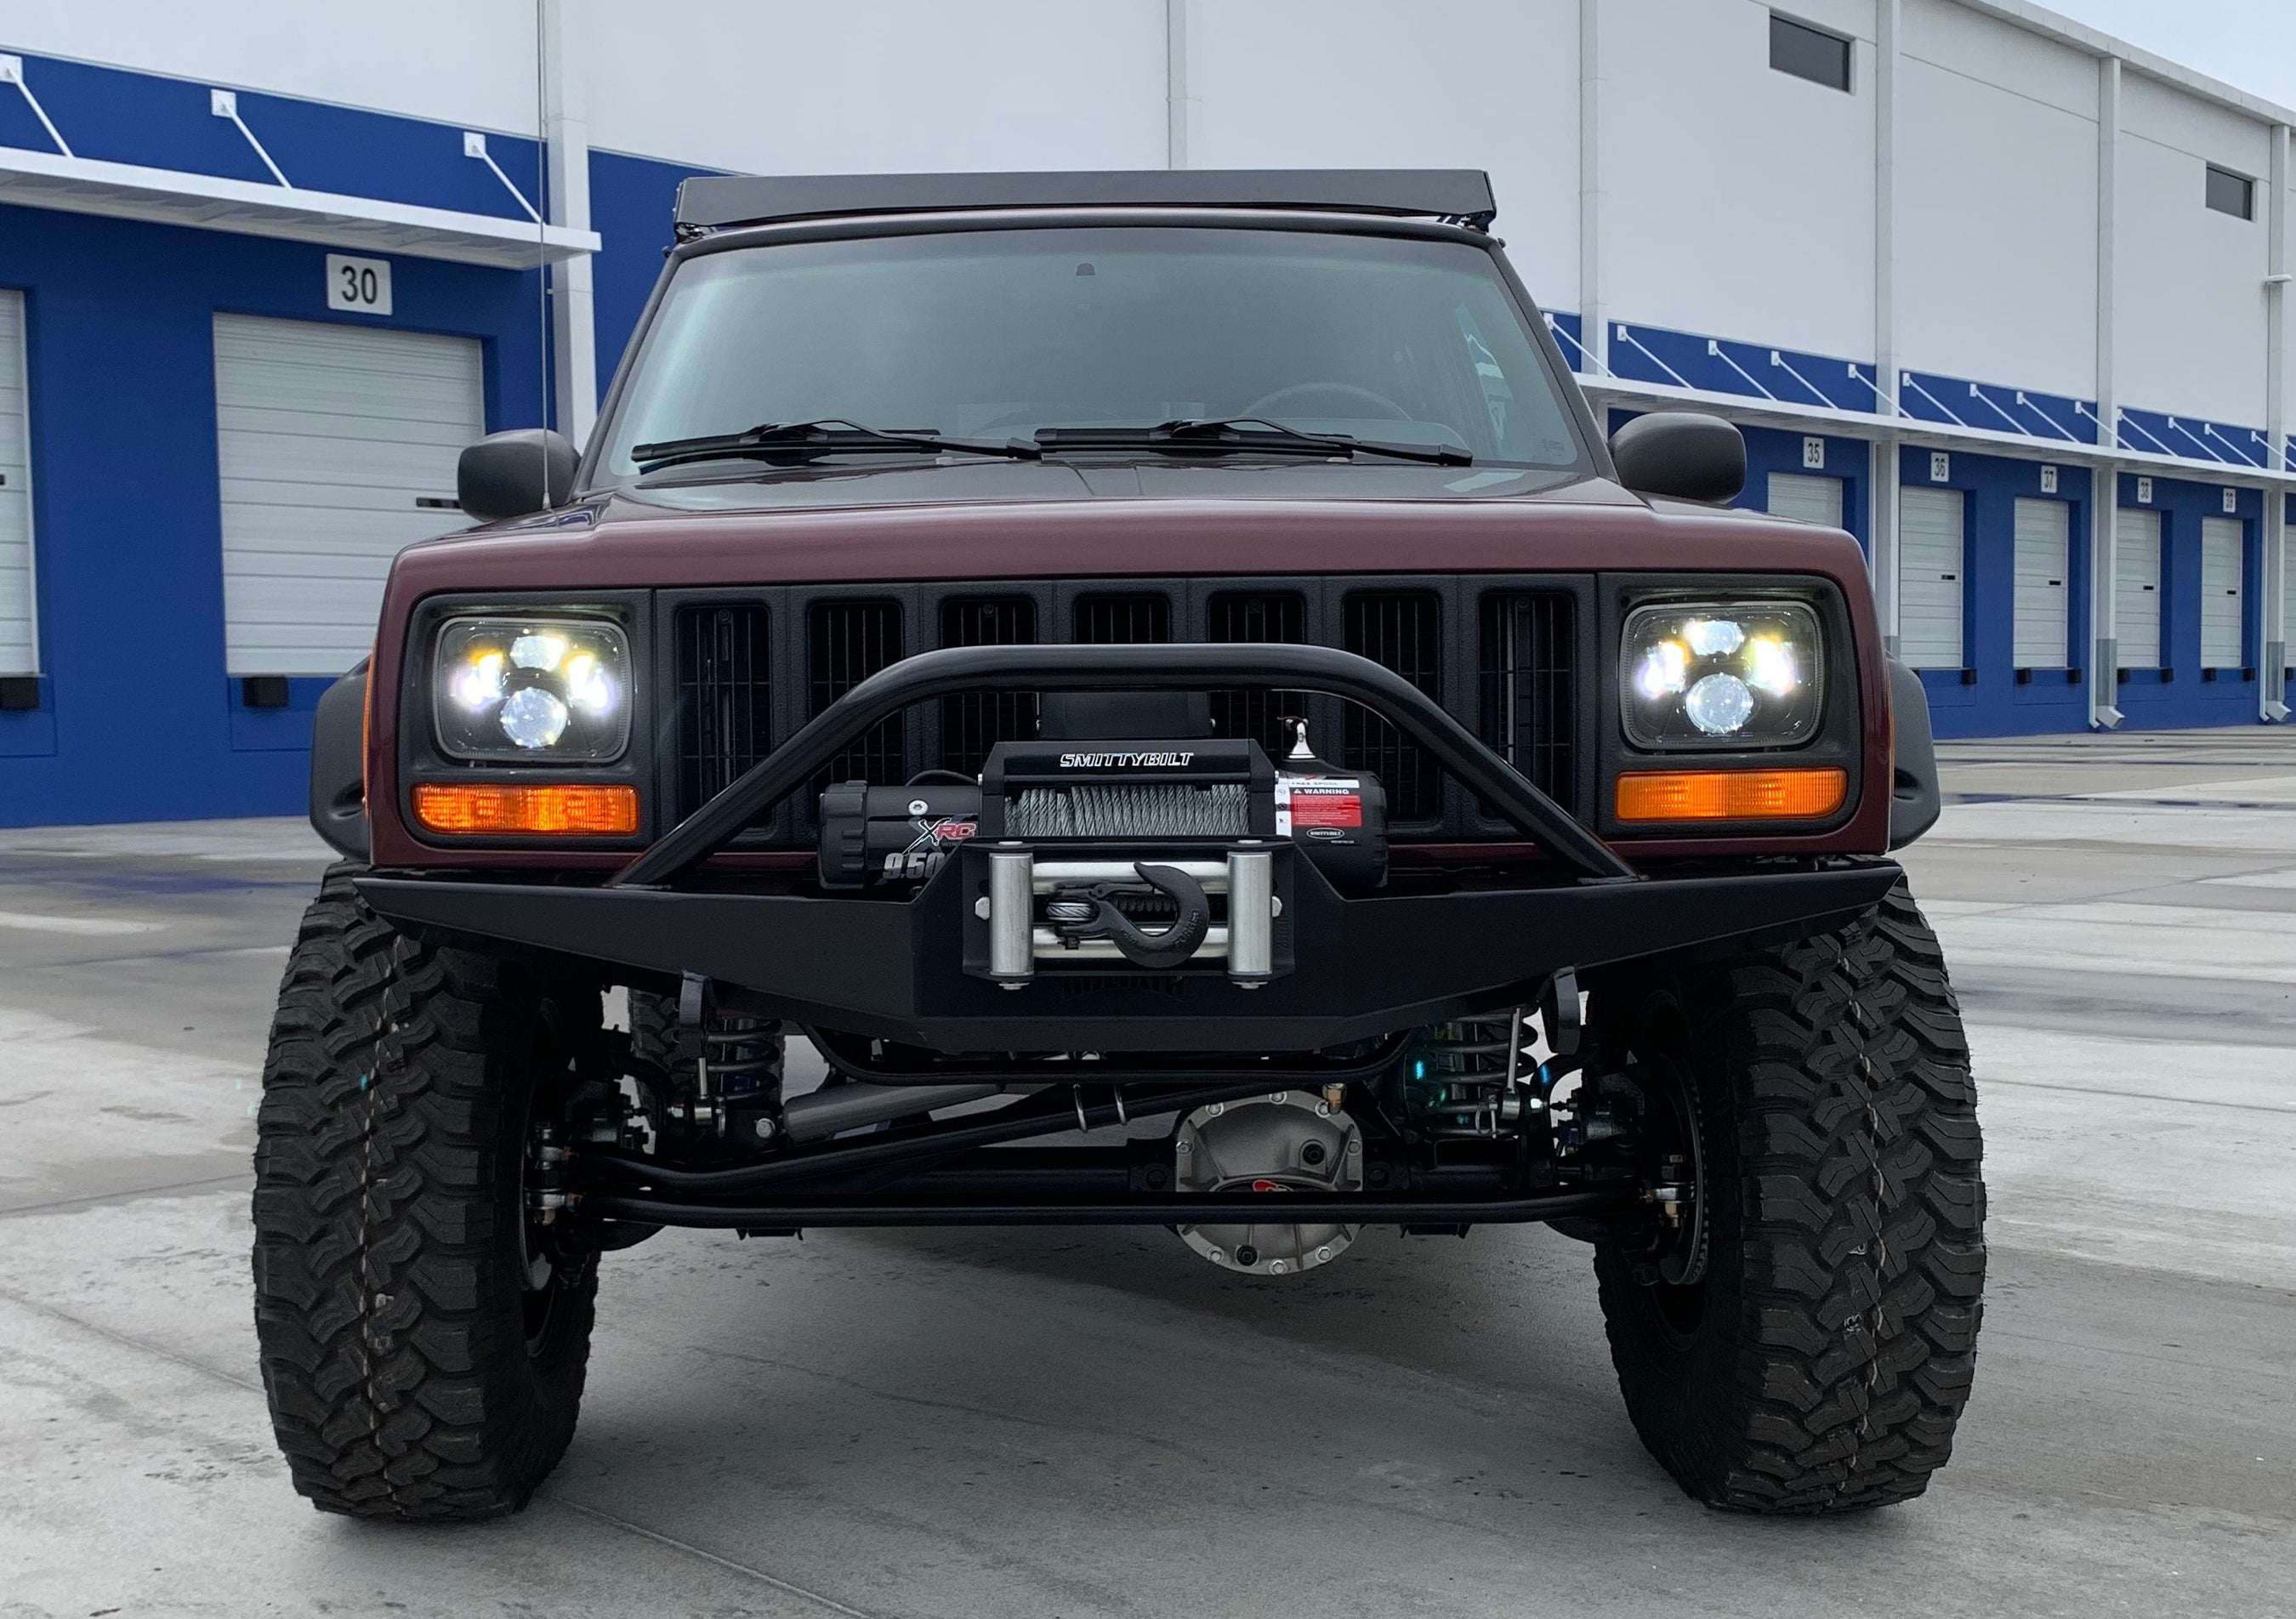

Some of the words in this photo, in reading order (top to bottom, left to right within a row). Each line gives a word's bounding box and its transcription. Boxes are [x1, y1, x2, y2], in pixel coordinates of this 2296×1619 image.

[342, 265, 378, 304] 30
[1808, 442, 1820, 463] 35
[1934, 457, 1946, 477] 36
[2044, 470, 2054, 489] 37
[1060, 752, 1194, 767] SMITTYBILT
[901, 816, 977, 856] XRC
[883, 852, 951, 879] 9.50
